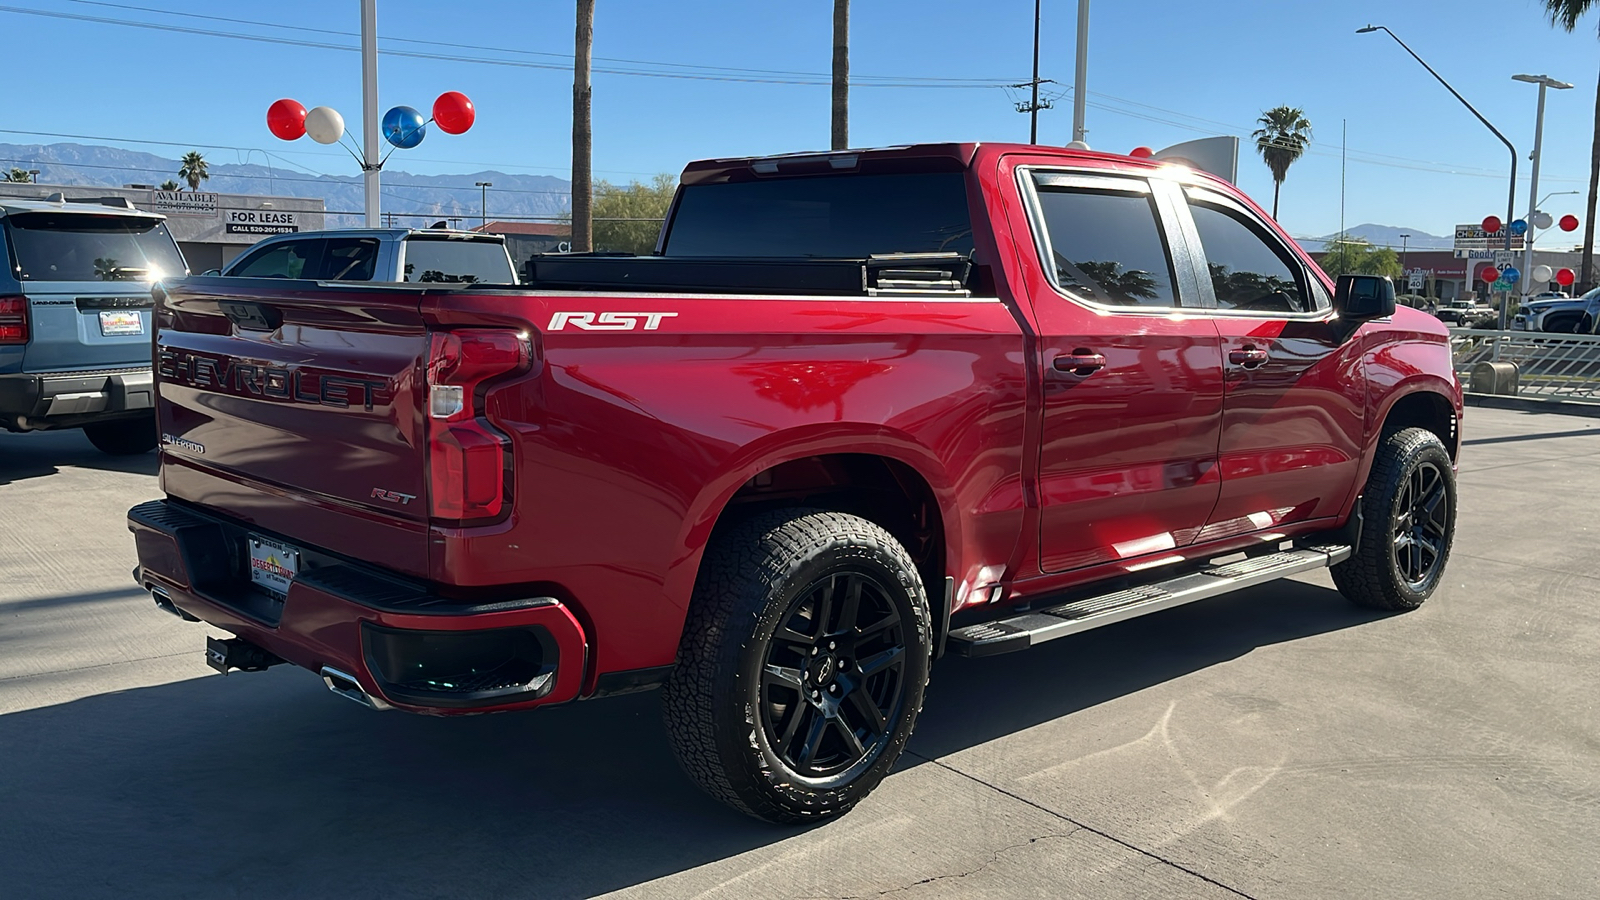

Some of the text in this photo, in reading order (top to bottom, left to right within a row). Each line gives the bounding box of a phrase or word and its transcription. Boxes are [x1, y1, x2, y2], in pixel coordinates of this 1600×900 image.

[155, 192, 216, 203] AVAILABLE
[231, 212, 293, 224] FOR LEASE
[1497, 263, 1512, 272] 40
[547, 312, 679, 331] RST
[158, 350, 388, 412] CHEVROLET
[162, 432, 205, 454] SILVERADO
[370, 487, 417, 504] RST
[251, 557, 273, 573] DESERT
